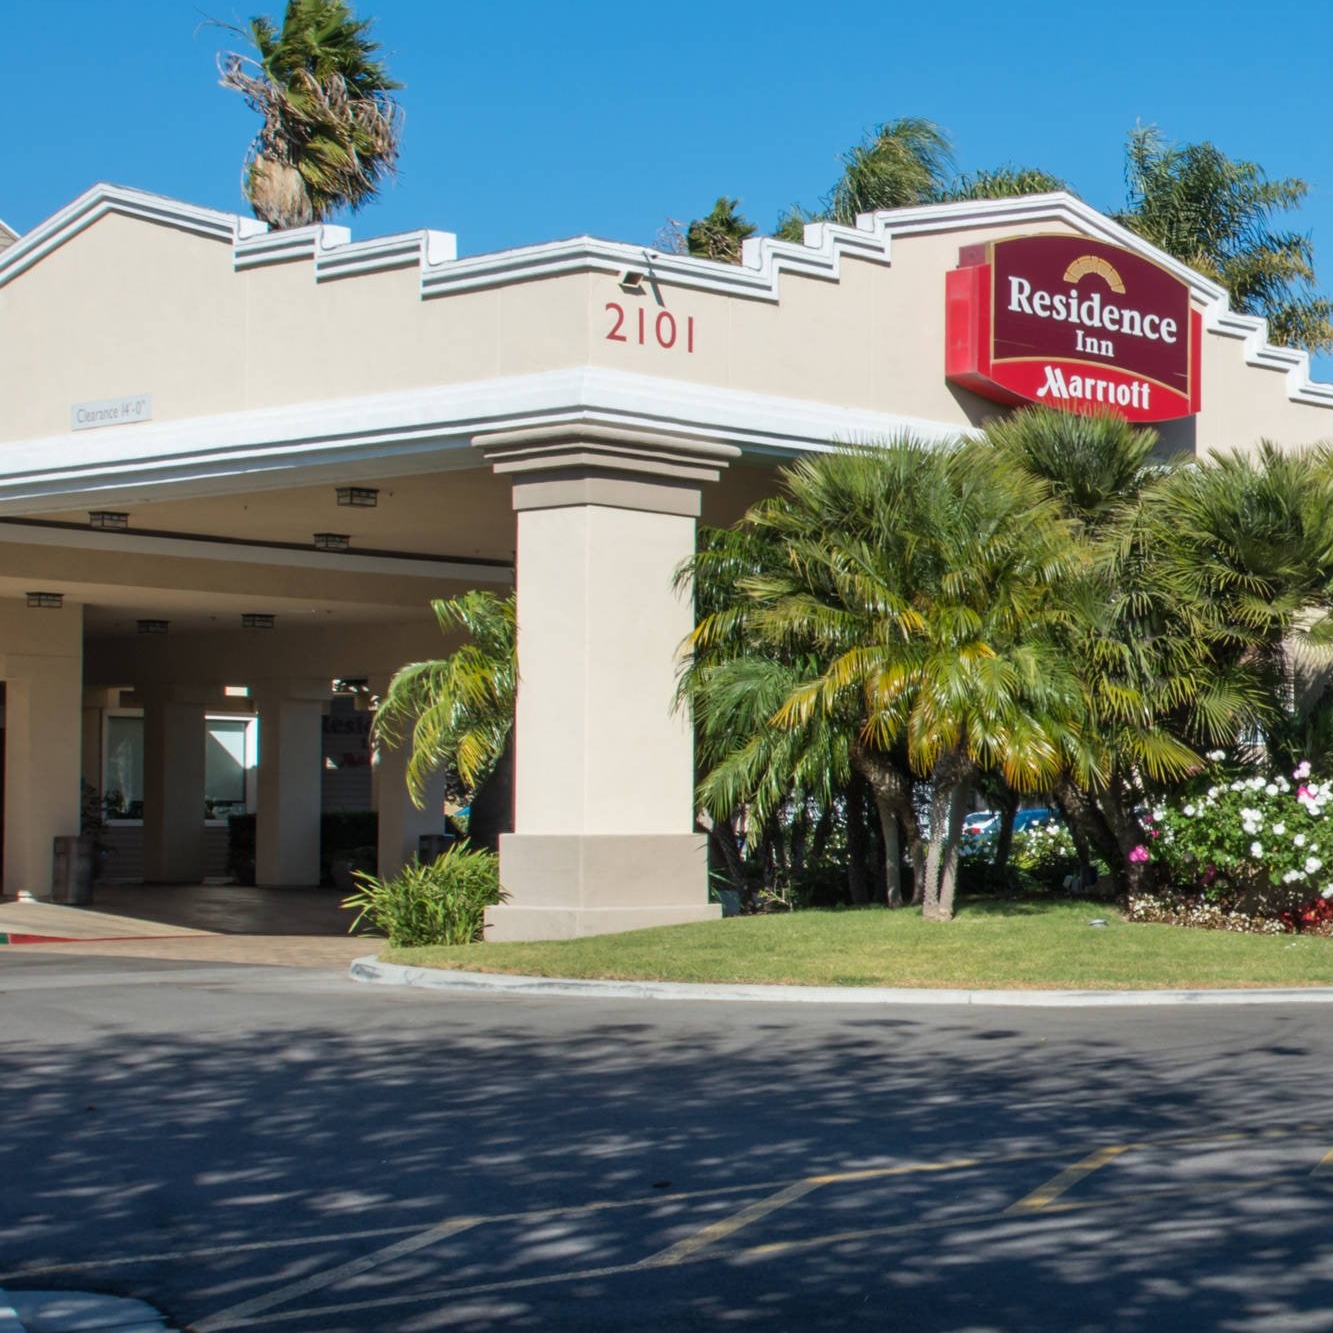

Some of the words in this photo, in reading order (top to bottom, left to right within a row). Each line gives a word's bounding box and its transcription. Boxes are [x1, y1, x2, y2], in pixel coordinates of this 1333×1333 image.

[605, 302, 694, 354] 2101
[1008, 276, 1178, 343] Residence
[1075, 329, 1115, 358] Inn
[1036, 365, 1151, 410] Marriott
[77, 407, 118, 424] Clearance
